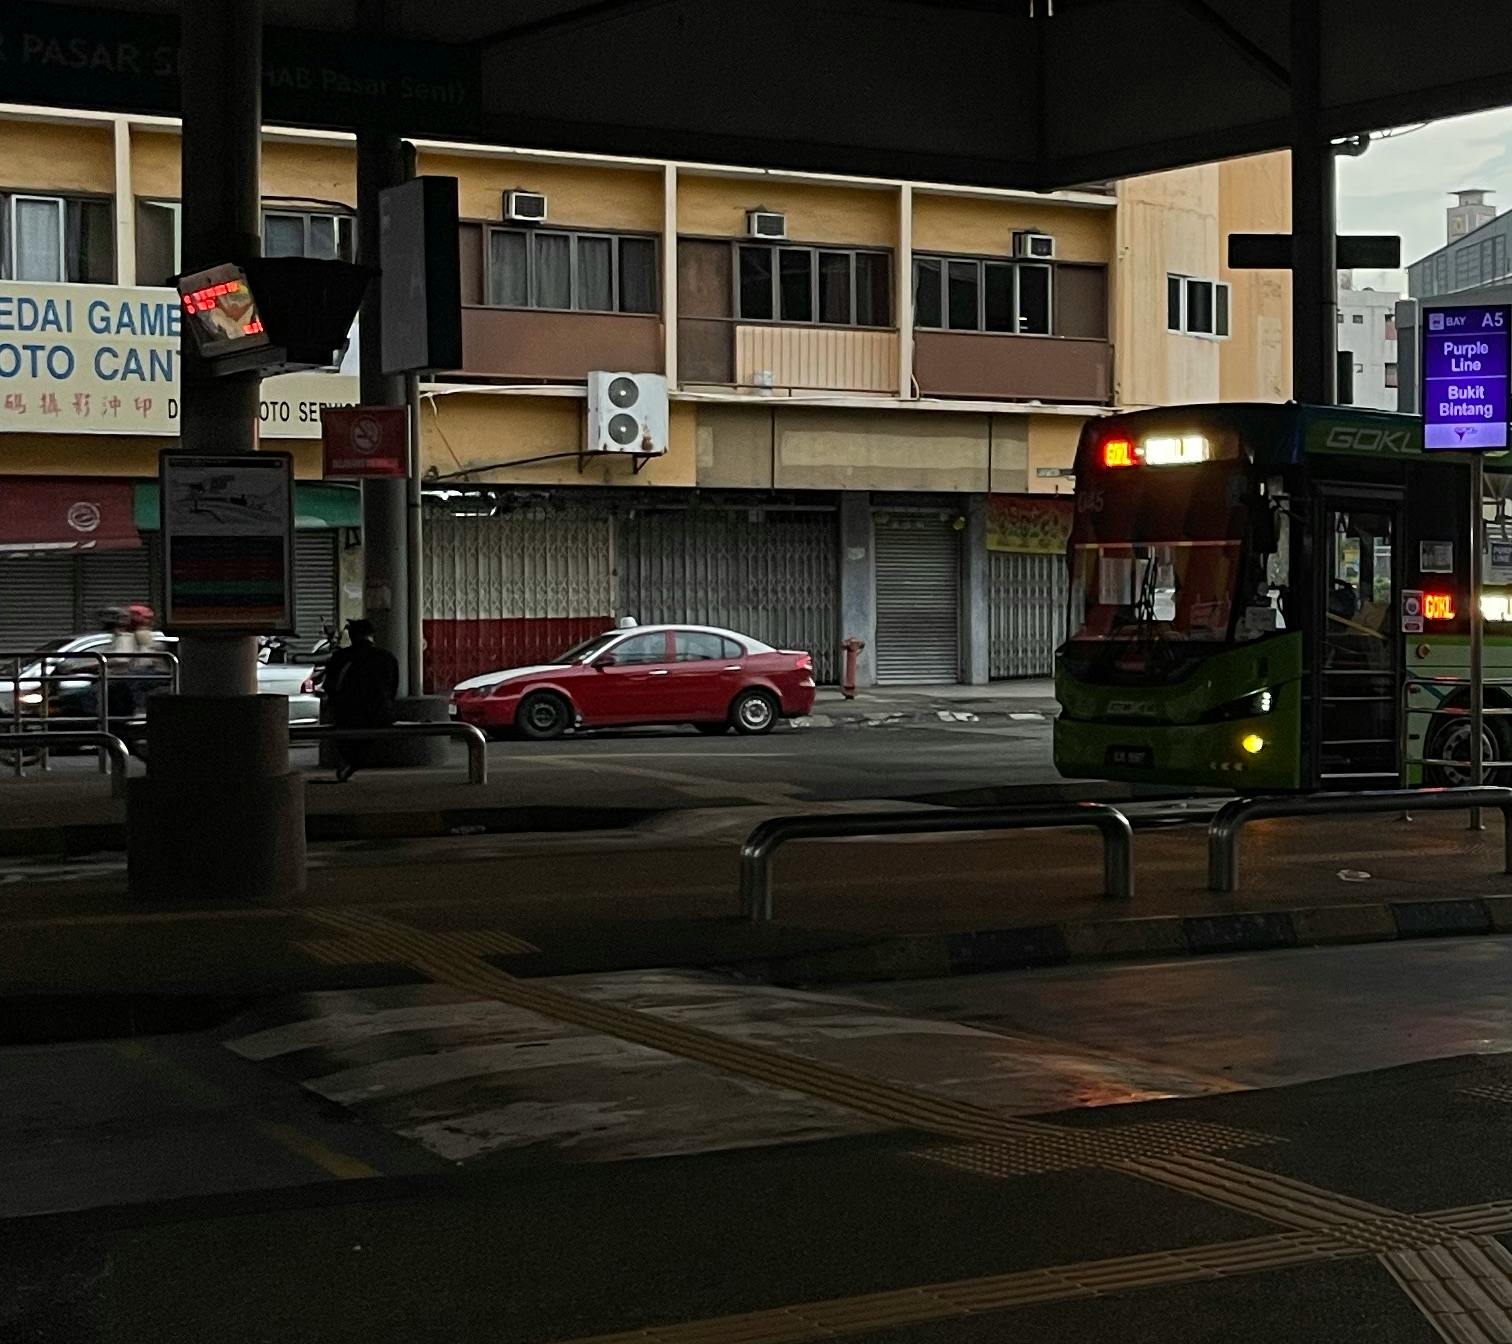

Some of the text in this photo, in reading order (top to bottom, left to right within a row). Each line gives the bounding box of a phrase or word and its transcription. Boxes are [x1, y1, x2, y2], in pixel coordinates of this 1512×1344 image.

[21, 31, 142, 75] PASAR
[0, 297, 181, 337] EDAI GAME
[1445, 311, 1504, 328] BAY A5
[1443, 341, 1489, 358] Purple
[94, 346, 181, 383] CAN
[1451, 358, 1482, 372] Line
[1447, 385, 1485, 400] Bukit
[1439, 402, 1494, 419] Bintang
[1326, 426, 1423, 454] GOKL
[1425, 594, 1456, 619] GOKL
